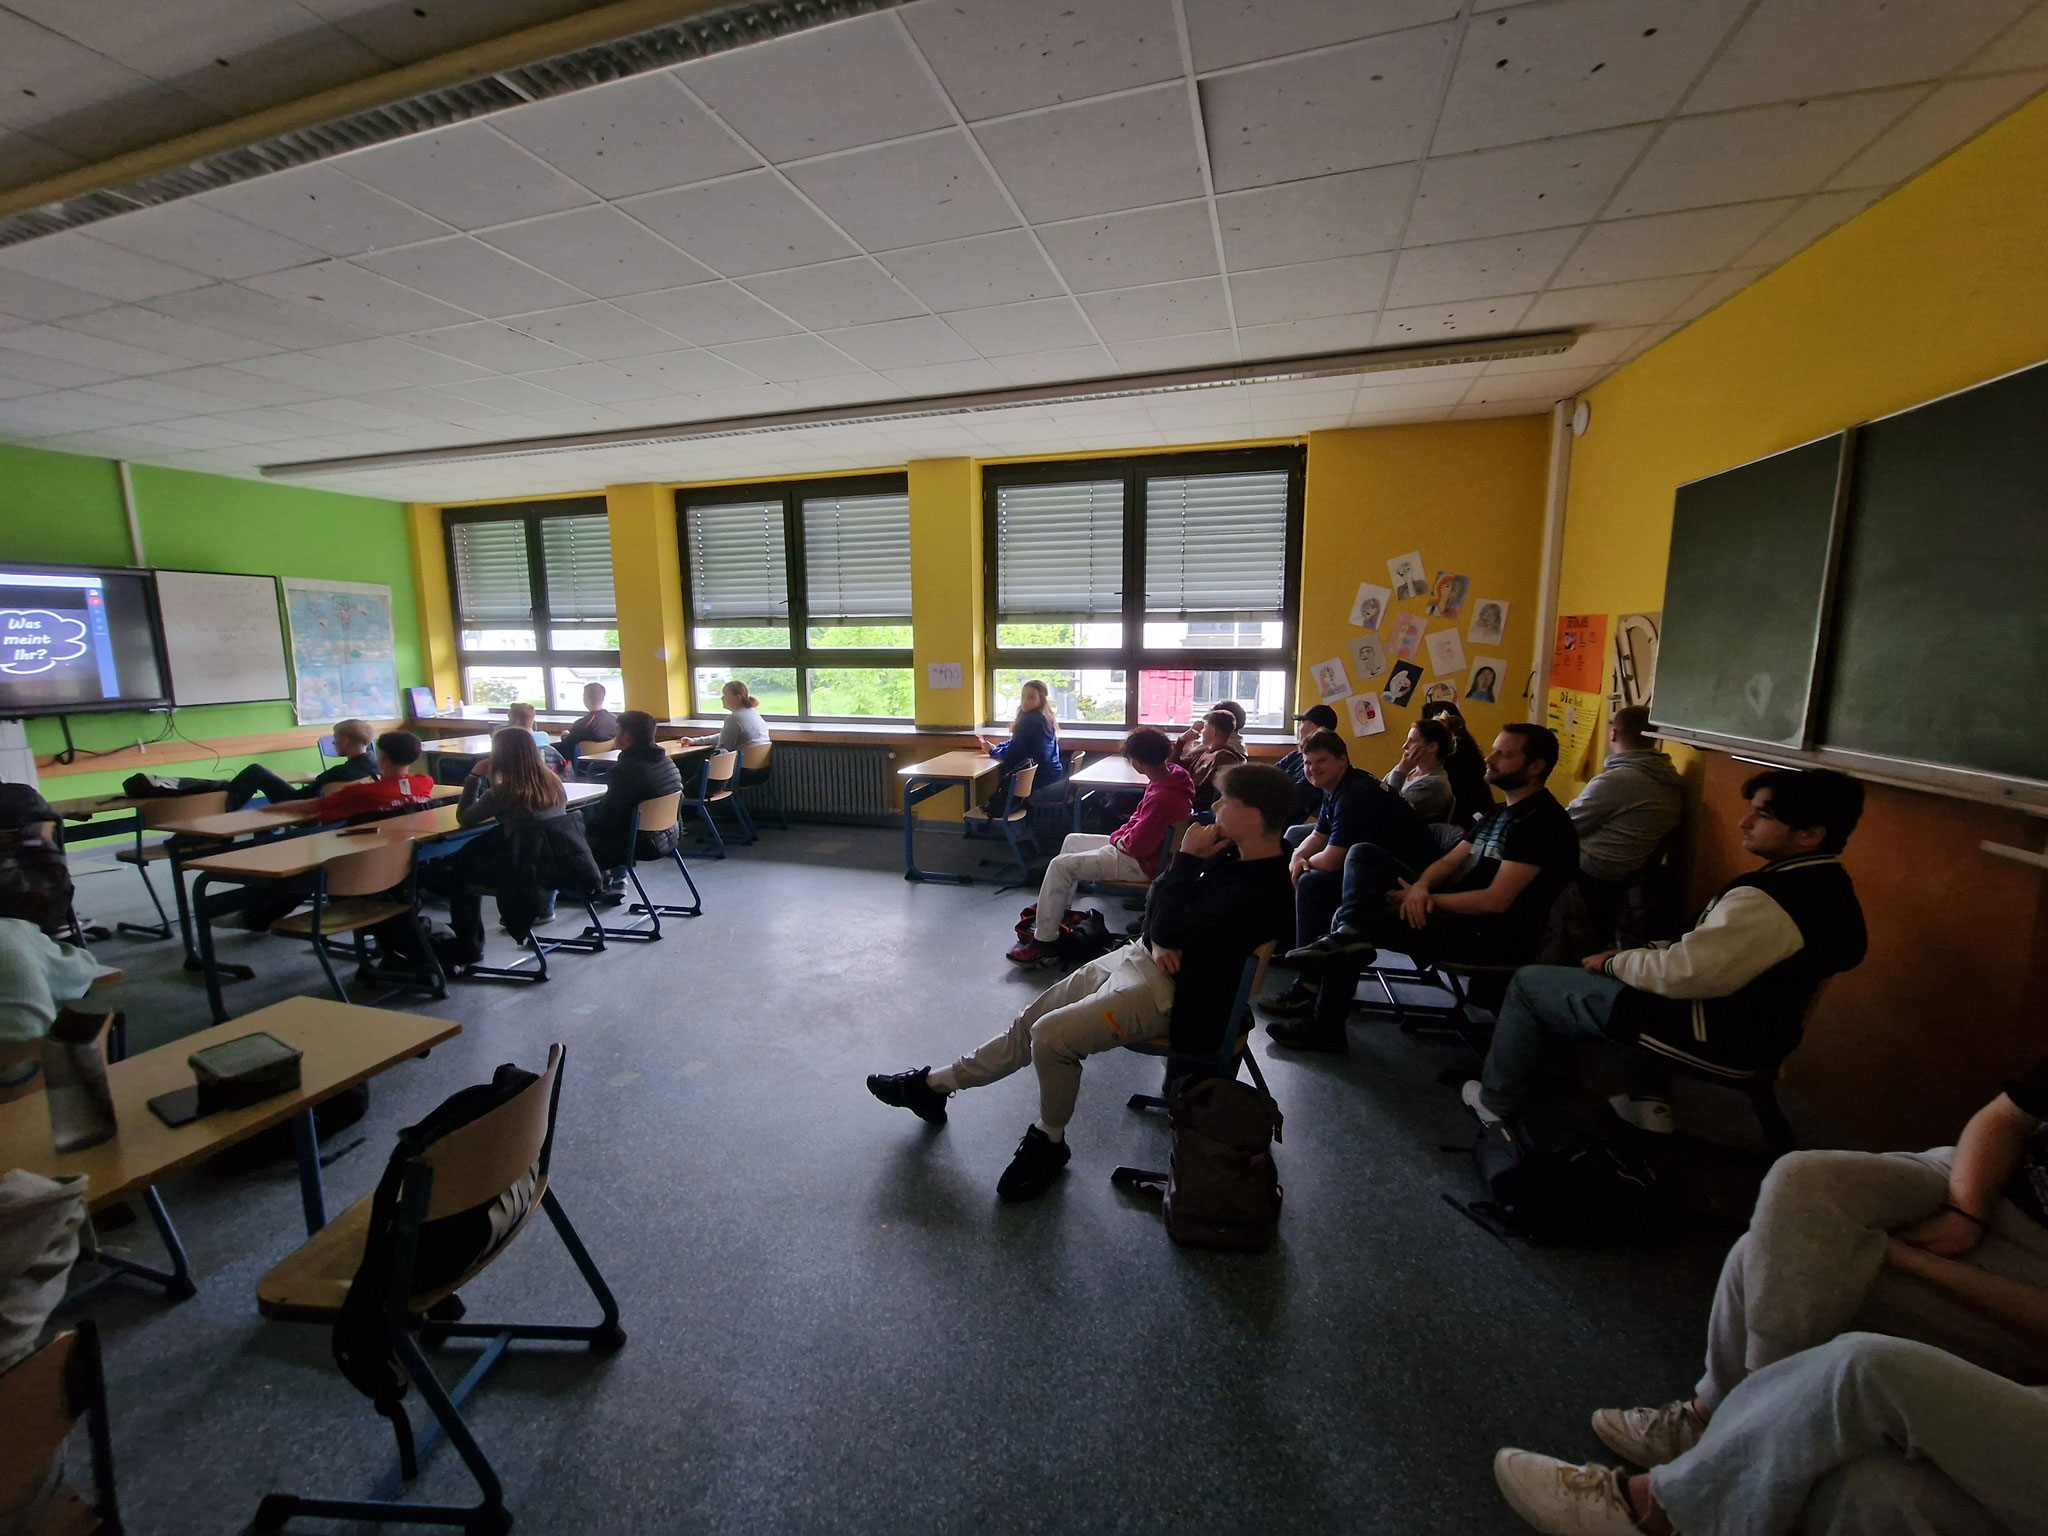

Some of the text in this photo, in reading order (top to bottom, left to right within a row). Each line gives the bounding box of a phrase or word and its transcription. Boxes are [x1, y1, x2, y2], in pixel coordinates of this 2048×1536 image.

[8, 618, 42, 630] Was
[3, 634, 52, 645] meint
[15, 649, 48, 660] Ihr?
